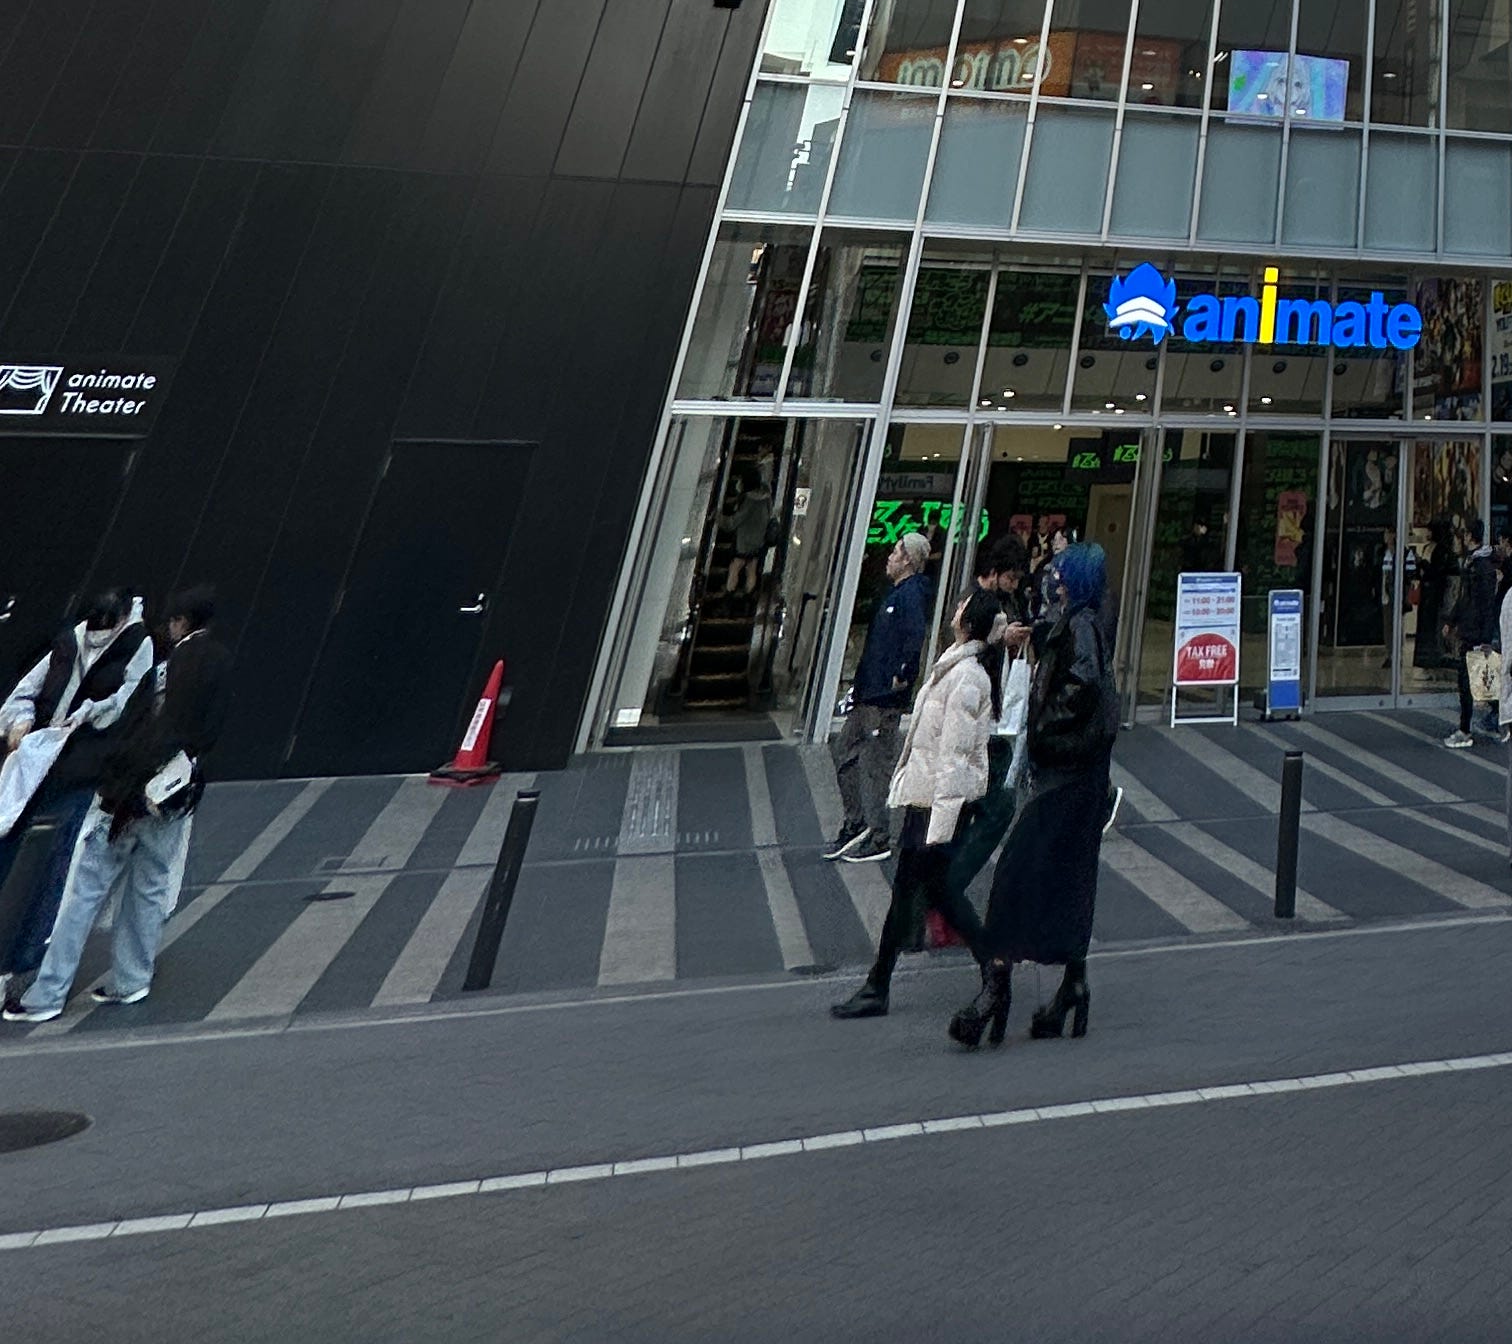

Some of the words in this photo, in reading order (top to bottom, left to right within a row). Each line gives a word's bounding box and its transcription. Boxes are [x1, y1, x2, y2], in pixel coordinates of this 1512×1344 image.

[1183, 266, 1424, 351] animate
[68, 369, 157, 390] animate
[60, 392, 147, 415] Theater
[1187, 645, 1206, 658] TAX
[1206, 644, 1228, 657] FREE
